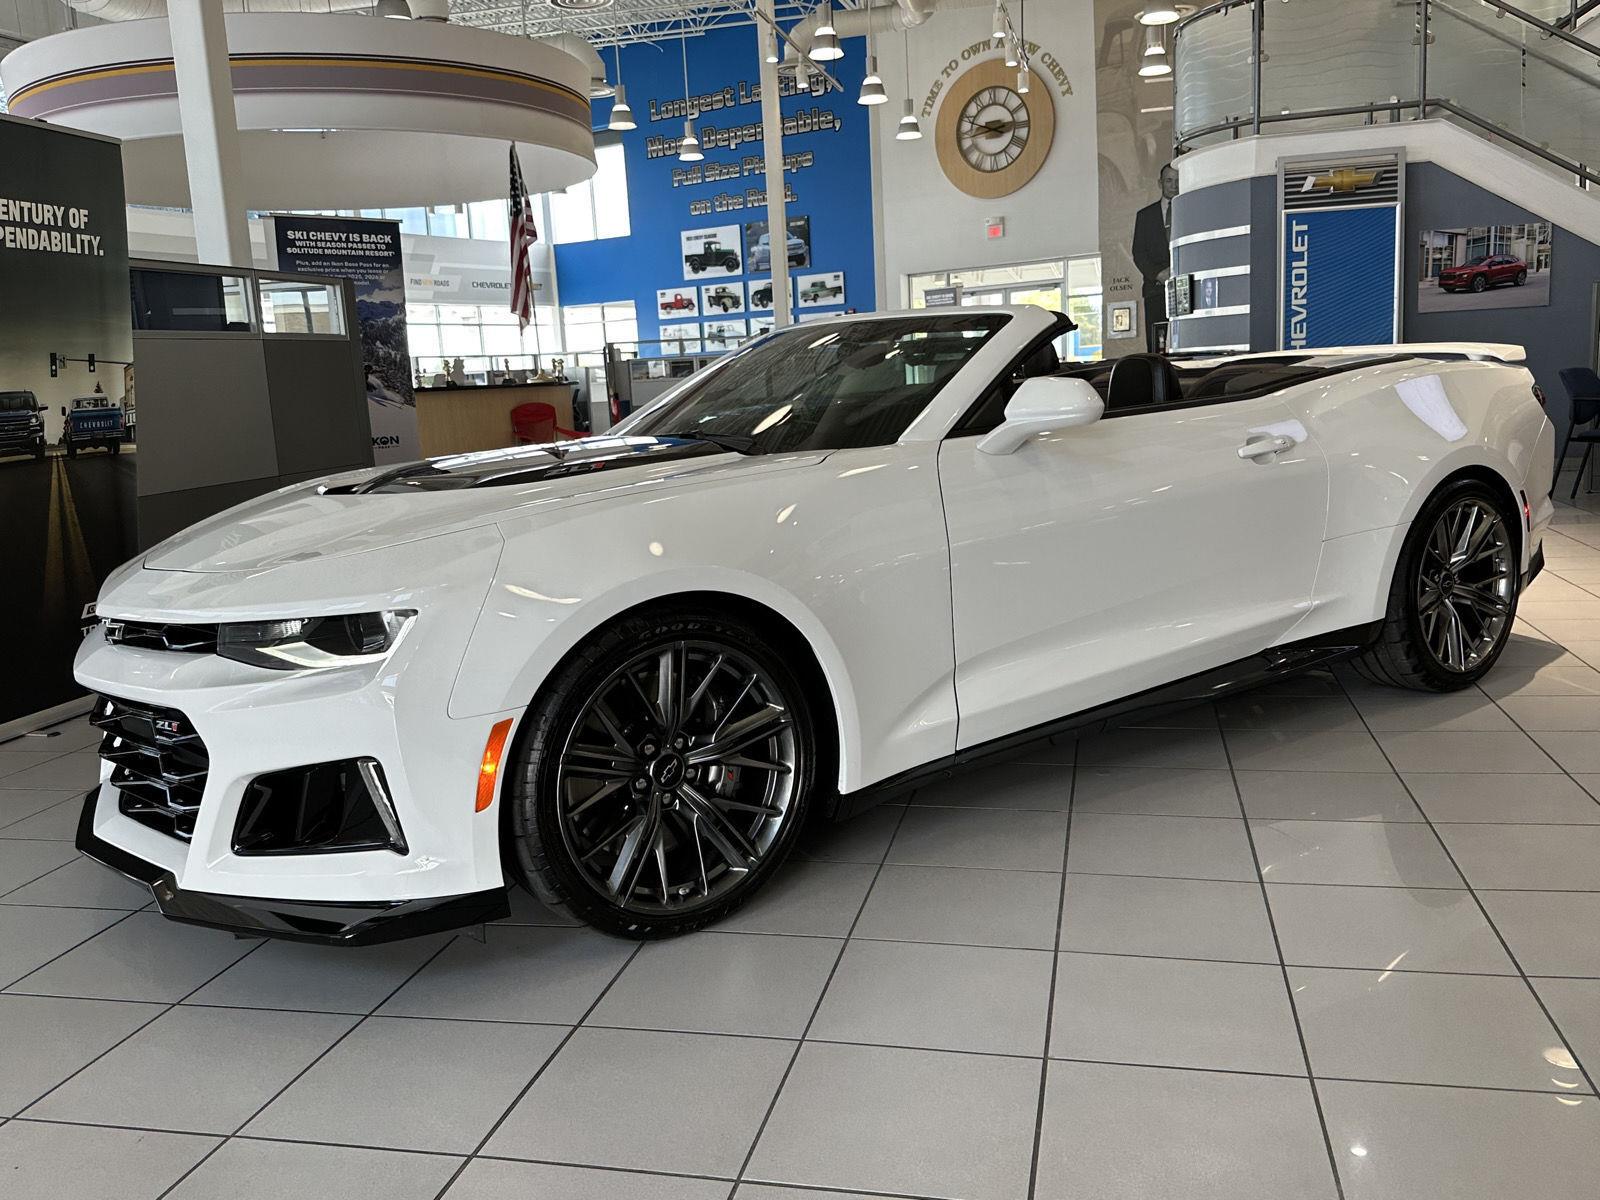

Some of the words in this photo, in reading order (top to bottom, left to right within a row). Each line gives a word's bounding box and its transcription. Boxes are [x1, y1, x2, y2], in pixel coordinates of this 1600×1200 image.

[922, 79, 944, 118] TIME
[942, 59, 959, 78] TO
[961, 39, 991, 61] OWN
[1040, 52, 1073, 97] CHEVY
[650, 86, 735, 122] Longest
[738, 75, 833, 105] Latig,
[646, 135, 698, 159] Mos
[701, 107, 842, 150] Depenable,
[672, 164, 702, 187] Full
[704, 162, 740, 182] Size
[742, 151, 814, 176] Piups
[690, 199, 712, 216] on
[713, 193, 743, 213] the
[746, 183, 798, 208] Rod.
[68, 207, 89, 229] OF
[286, 231, 307, 240] SKI
[309, 232, 347, 242] CHEVY
[349, 233, 361, 242] IS
[362, 234, 392, 244] BACK
[286, 247, 323, 255] SOLITUDE
[324, 248, 364, 256] MOUNTAIN
[295, 240, 316, 248] WITH
[317, 241, 347, 249] SEASON
[348, 242, 376, 250] PASSES
